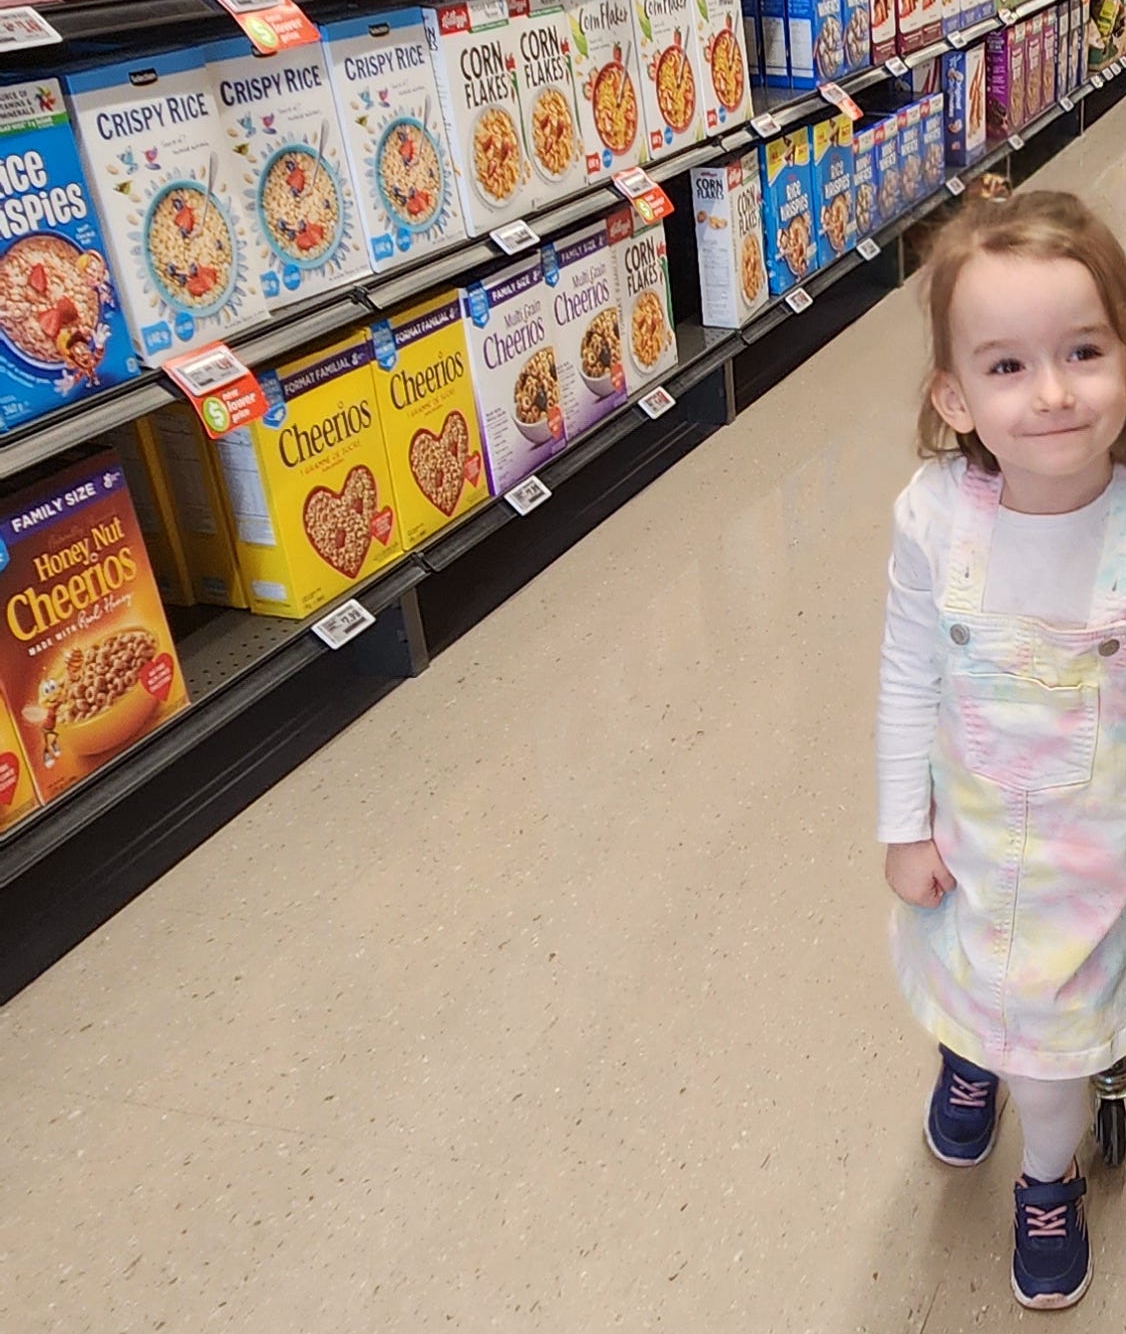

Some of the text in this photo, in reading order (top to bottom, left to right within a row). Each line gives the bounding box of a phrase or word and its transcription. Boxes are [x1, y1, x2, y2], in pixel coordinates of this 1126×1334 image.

[579, 0, 629, 34] Corn Flakes
[460, 41, 502, 82] CORN
[520, 25, 560, 63] CORN
[344, 45, 426, 82] CRISPY RICE
[525, 54, 564, 89] FLAKES
[219, 64, 323, 107] CRISPY RICE
[464, 73, 509, 109] FLAKES
[97, 92, 210, 141] CRISPY RICE
[696, 178, 723, 191] CORN
[625, 236, 656, 273] CORN
[492, 275, 531, 303] FAMILY SIZE
[627, 260, 658, 296] FLAKES
[554, 276, 610, 327] Cheerios
[483, 317, 546, 370] Cheerios
[221, 387, 240, 399] new
[284, 359, 351, 395] FORMAT FAMILIAL
[390, 348, 465, 411] Cheerios
[225, 391, 257, 413] lower
[231, 409, 250, 425] price
[278, 398, 372, 469] Cheerios
[11, 481, 97, 534] FAMILY SIZE
[33, 516, 125, 583] Honey Nut
[6, 545, 138, 642] Cheerios
[28, 637, 53, 657] MADE
[55, 625, 78, 642] WITH
